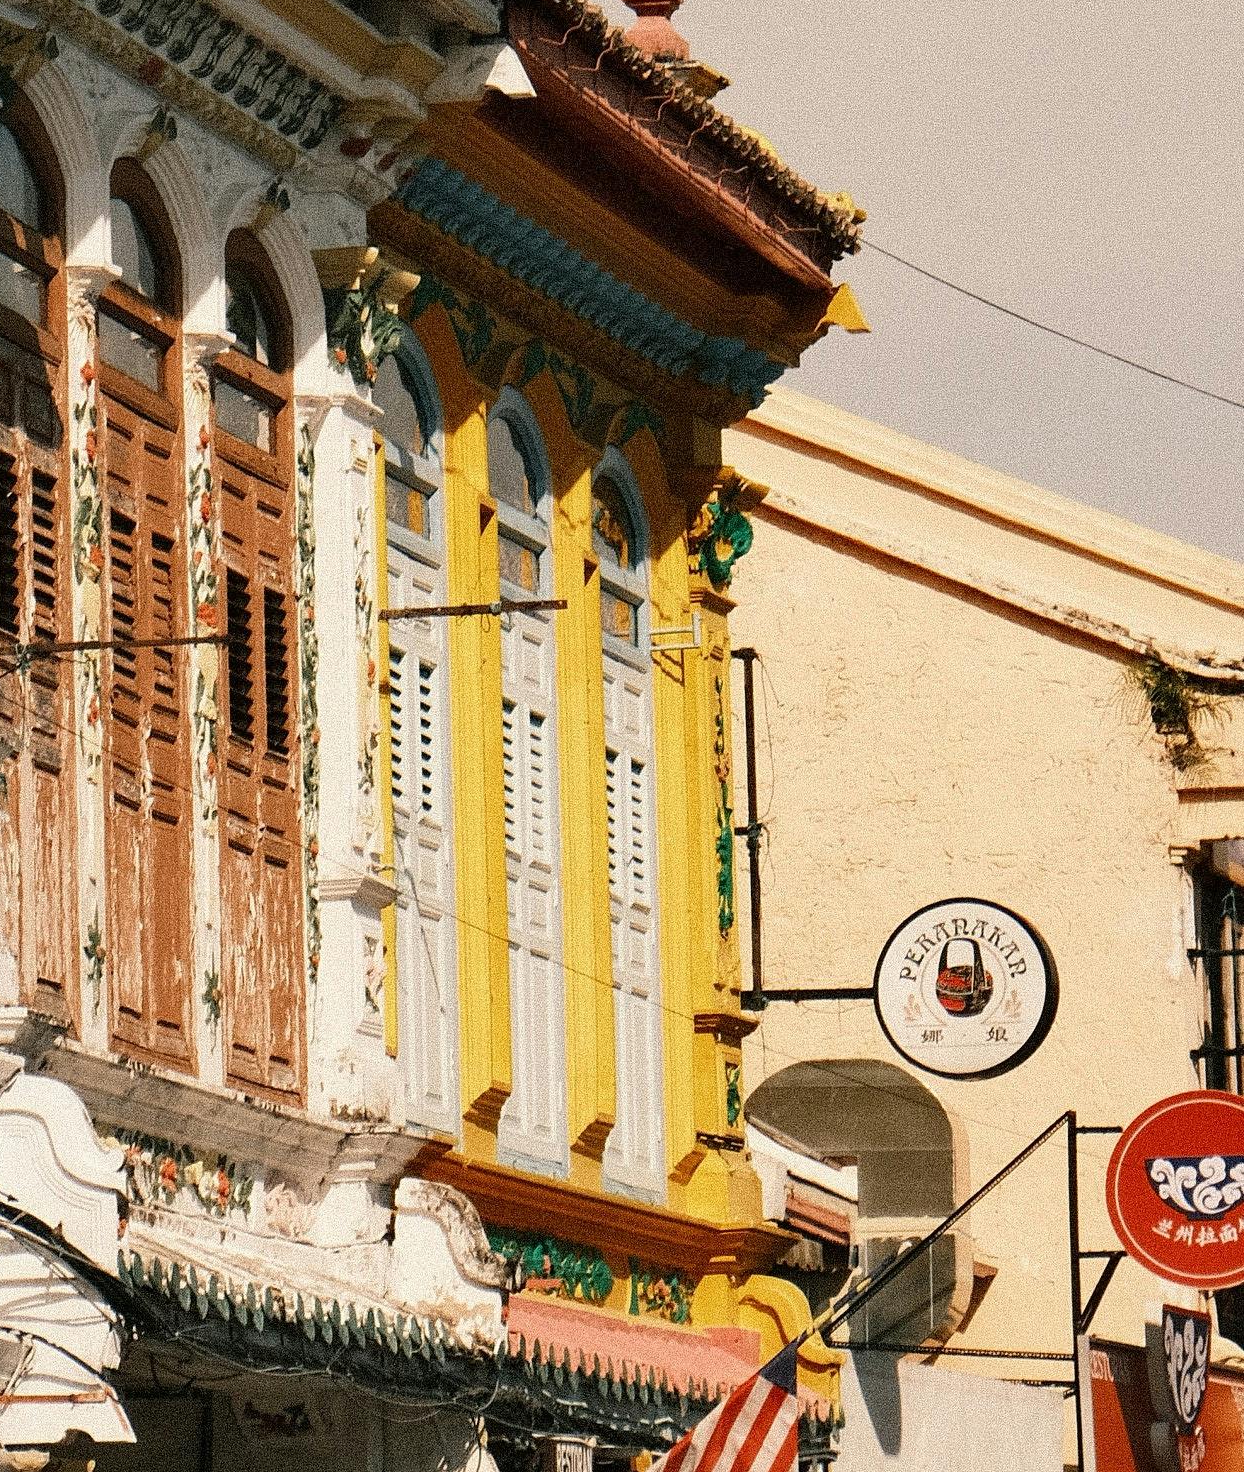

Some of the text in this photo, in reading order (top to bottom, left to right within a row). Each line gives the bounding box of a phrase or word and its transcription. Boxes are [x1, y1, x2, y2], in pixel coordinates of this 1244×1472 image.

[899, 918, 1027, 982] PERANAKAN
[1151, 1218, 1244, 1247] 兰州拉面
